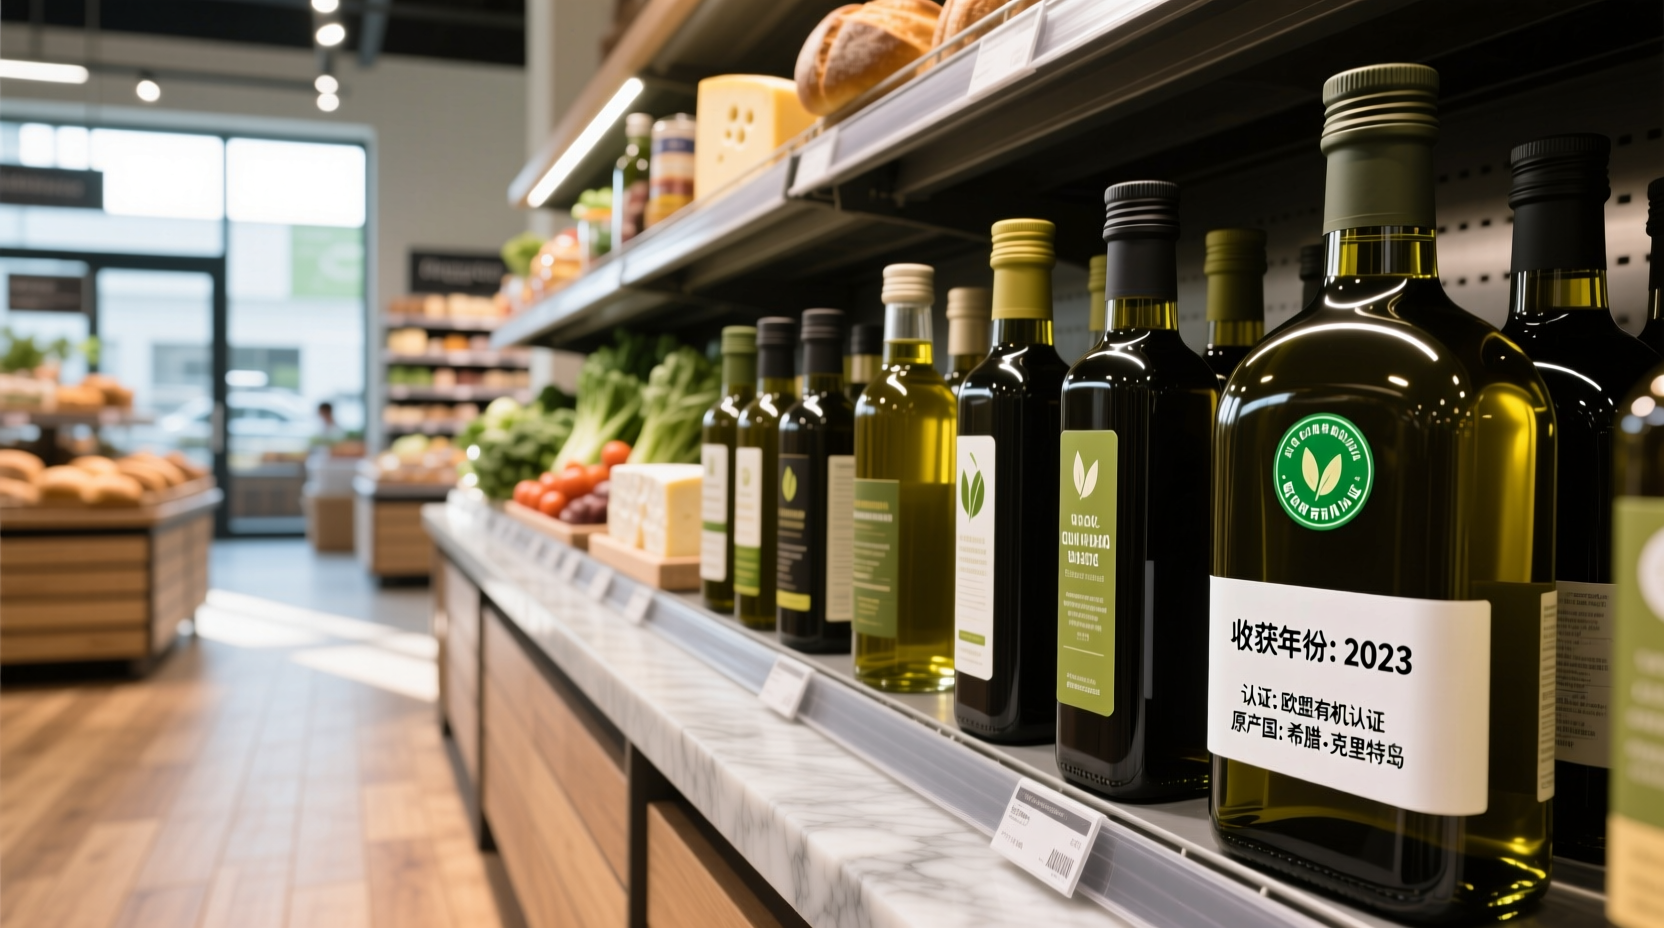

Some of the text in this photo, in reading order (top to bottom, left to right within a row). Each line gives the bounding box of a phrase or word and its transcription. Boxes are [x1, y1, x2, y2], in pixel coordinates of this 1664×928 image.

[1231, 618, 1412, 675] 收获年份: 2023
